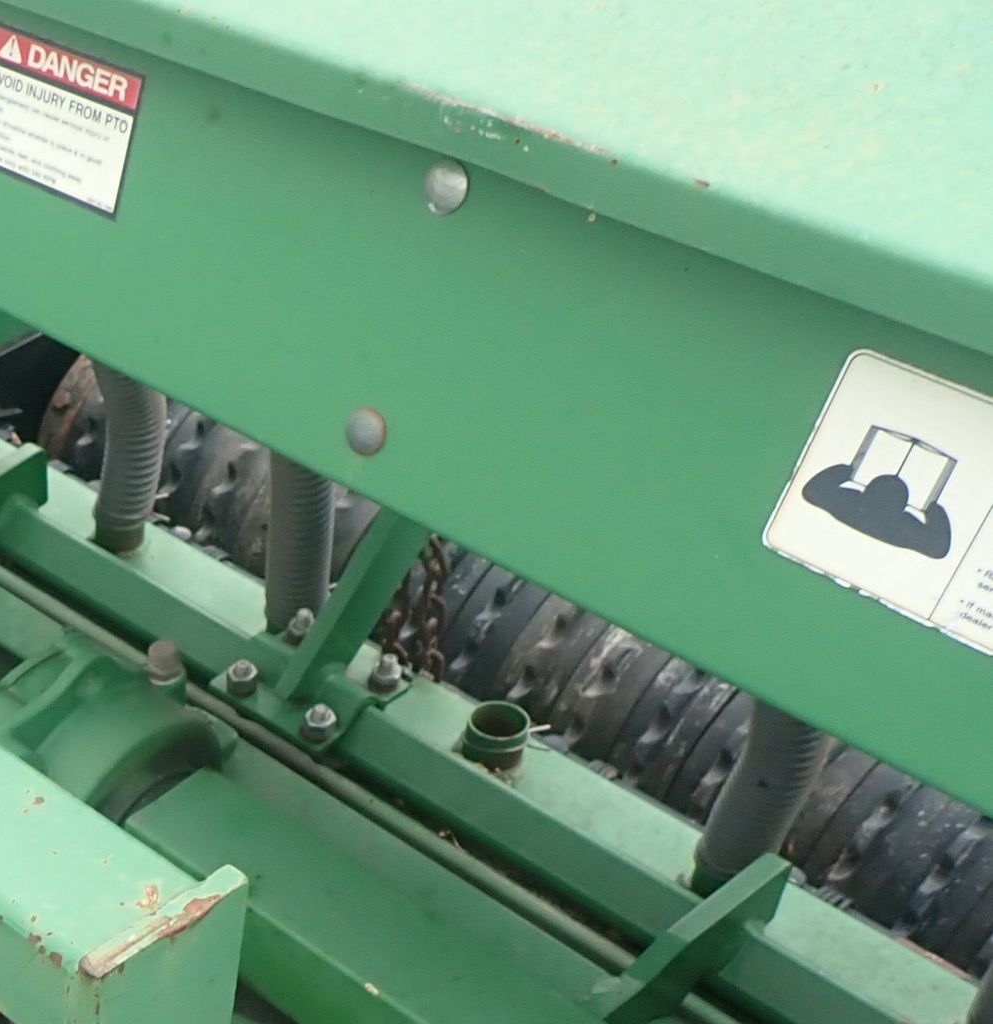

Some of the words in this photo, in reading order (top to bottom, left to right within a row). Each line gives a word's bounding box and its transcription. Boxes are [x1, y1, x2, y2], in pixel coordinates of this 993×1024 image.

[27, 44, 127, 101] DANGER
[25, 83, 65, 108] INJURY
[68, 99, 102, 123] FROM
[104, 113, 128, 133] PTO
